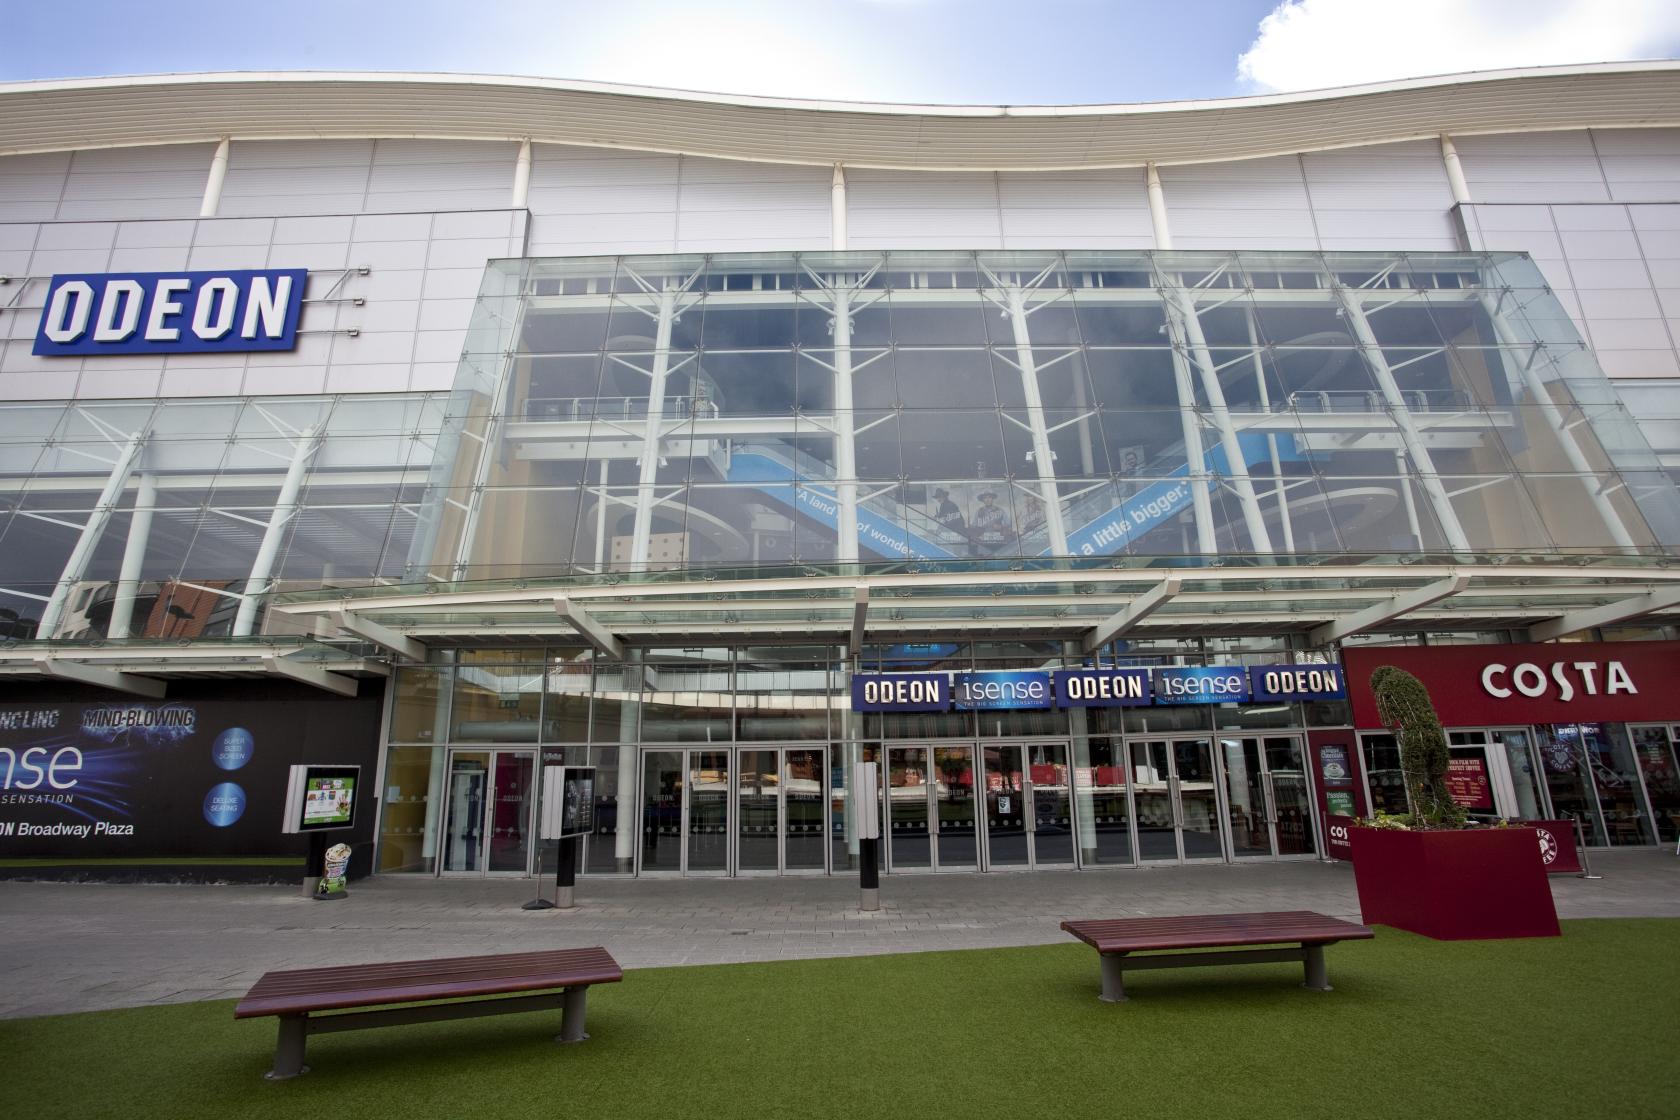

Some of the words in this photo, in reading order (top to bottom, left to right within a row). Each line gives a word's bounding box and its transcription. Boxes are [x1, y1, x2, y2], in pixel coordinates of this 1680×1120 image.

[44, 275, 293, 343] ODEON
[809, 495, 836, 516] land
[856, 521, 869, 533] of
[1081, 543, 1095, 556] a
[1092, 519, 1132, 548] little
[864, 680, 940, 704] ODEON
[964, 676, 1044, 700] isense
[1067, 675, 1142, 700] ODEON
[1163, 672, 1241, 695] isense
[1264, 670, 1338, 694] ODEON
[1481, 661, 1639, 702] COSTA
[83, 709, 194, 728] MIND-BLOWING
[1, 794, 74, 804] SENSATION
[17, 822, 91, 839] Broadway
[94, 821, 134, 836] Plaza
[1330, 825, 1348, 840] COS
